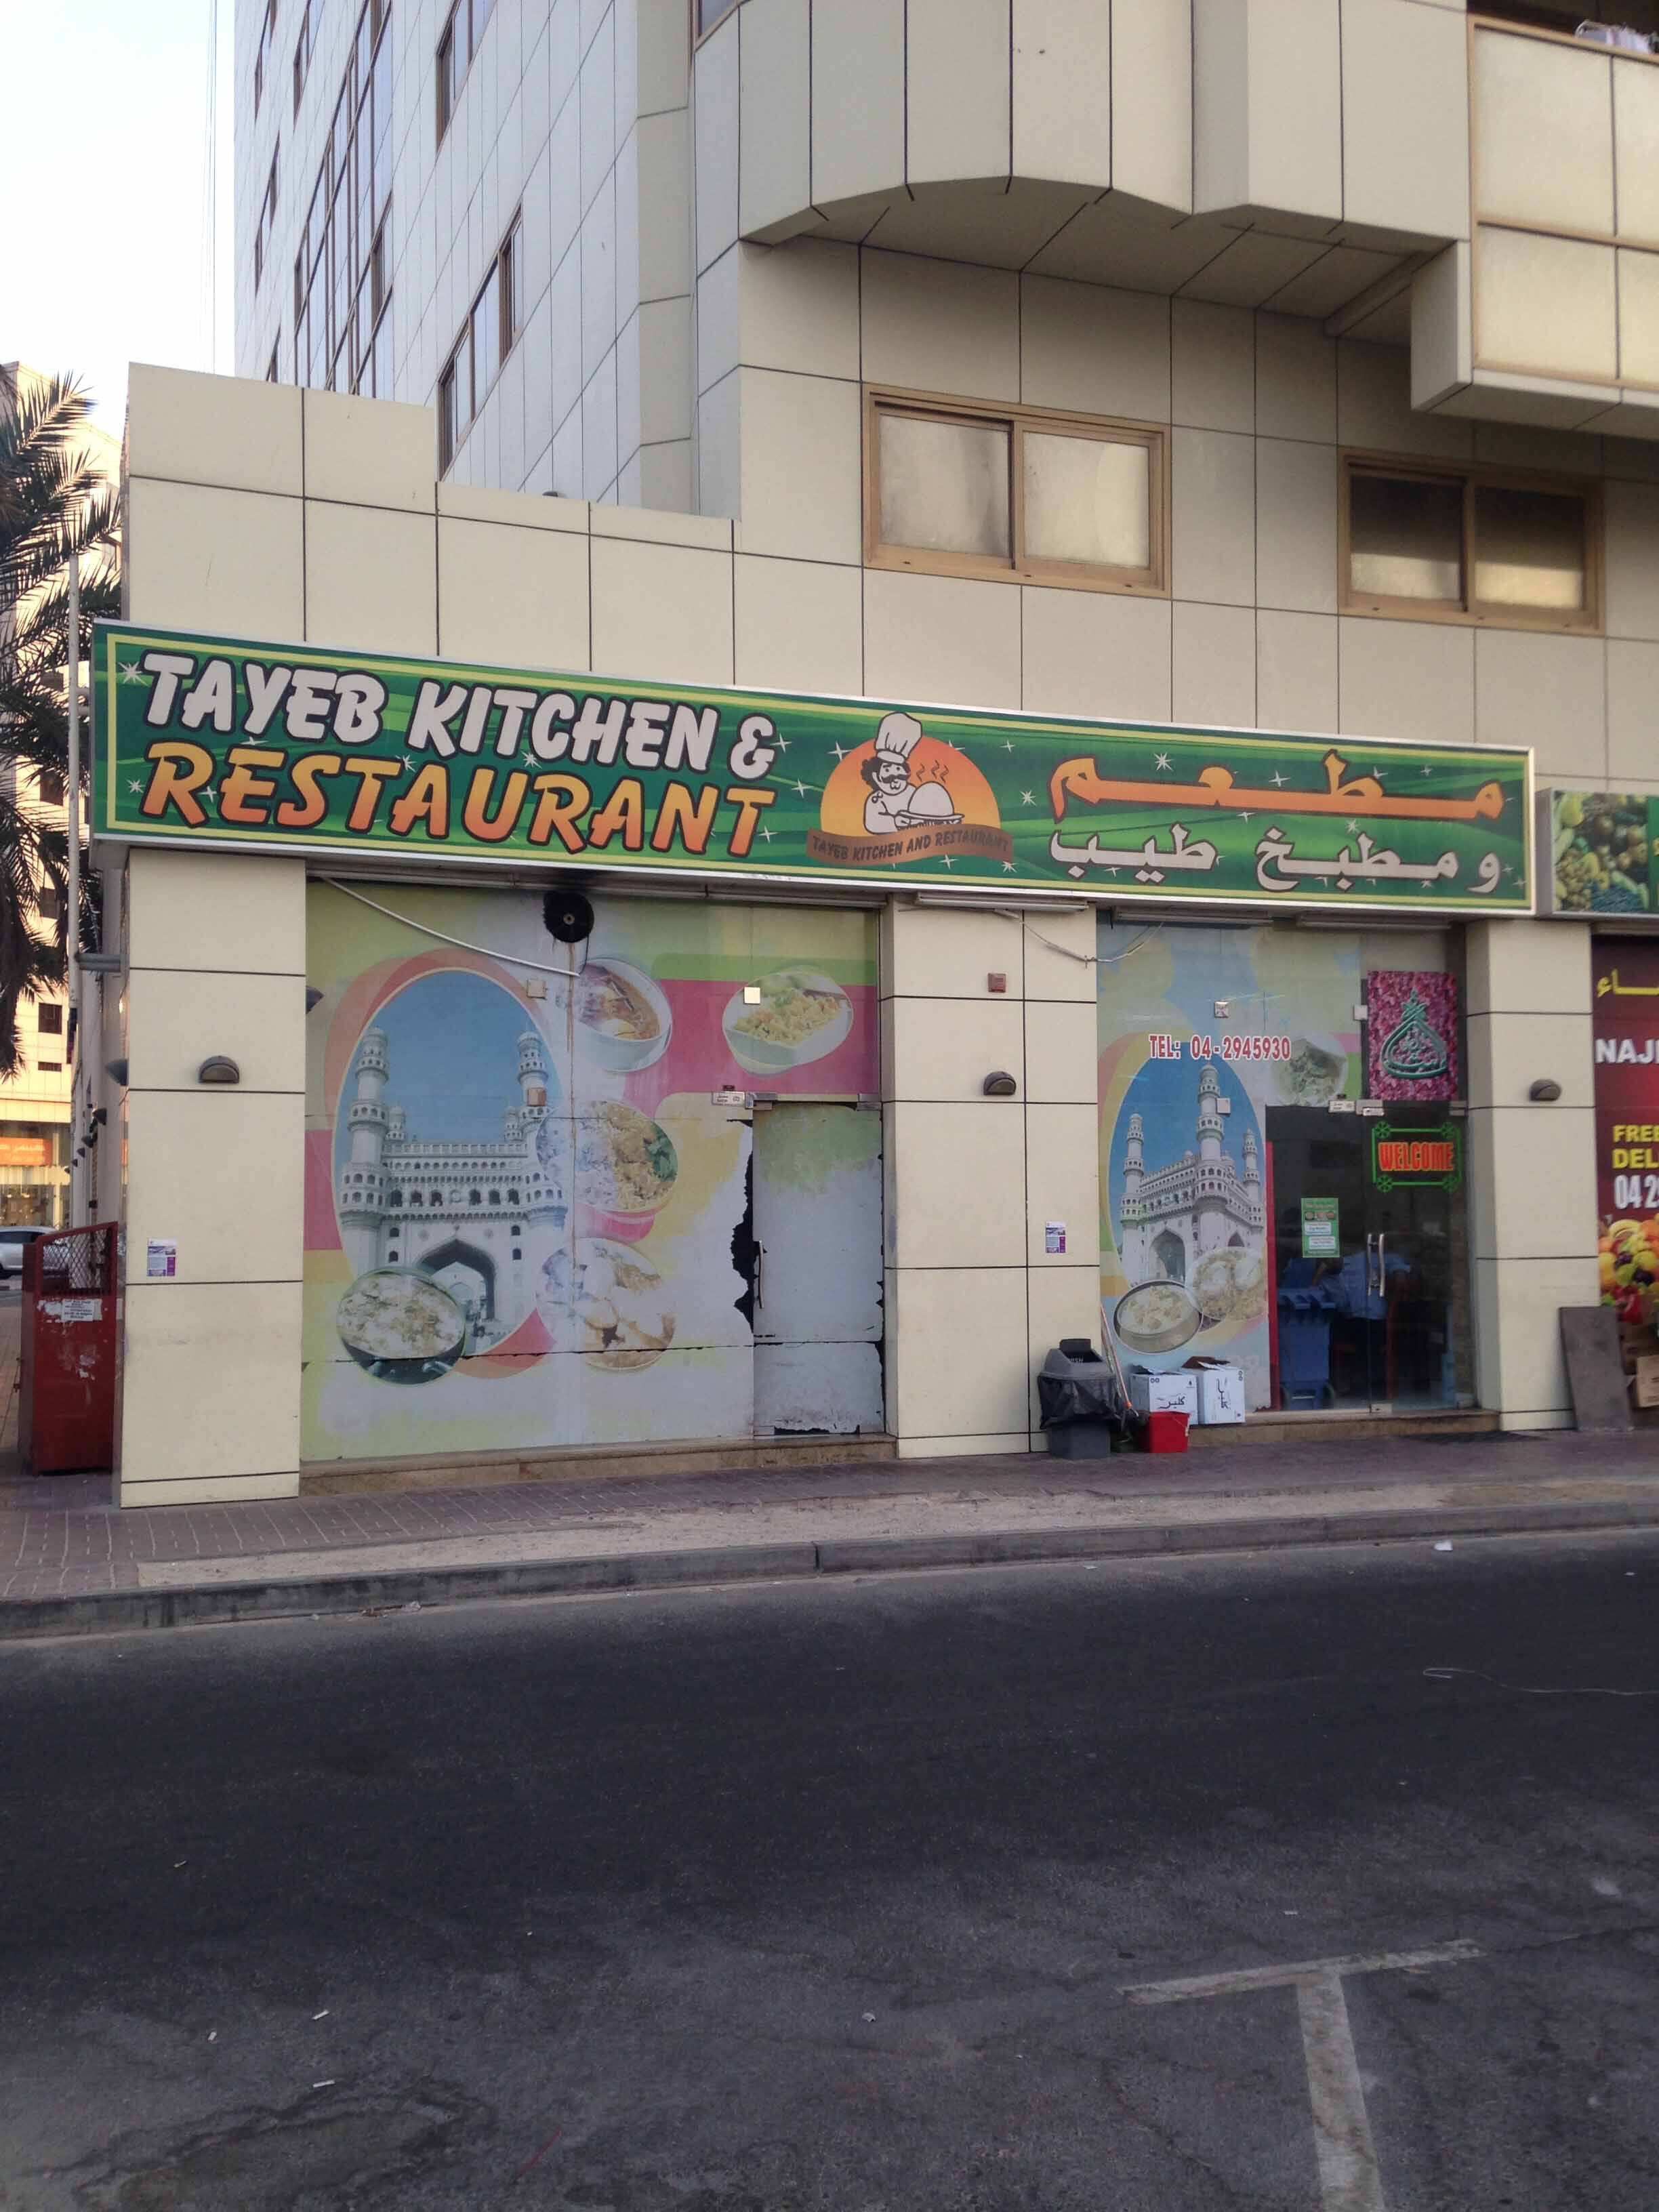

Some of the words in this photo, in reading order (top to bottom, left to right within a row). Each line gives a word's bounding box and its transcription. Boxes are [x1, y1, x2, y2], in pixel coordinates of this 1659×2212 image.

[141, 651, 387, 745] TAYEB
[407, 679, 719, 772] KITCHEN
[730, 715, 775, 779] &
[142, 742, 777, 855] RESTAURANT
[1049, 749, 1504, 823] مطعم
[813, 836, 848, 860] TAYEB
[853, 840, 903, 861] KITCHEN
[907, 834, 931, 854] AND
[935, 829, 1008, 853] RESTAURANT
[1050, 822, 1217, 884] طيب
[1149, 1034, 1181, 1059] TEL:
[1595, 1038, 1659, 1064] NAJ
[1378, 1141, 1454, 1172] WELCOME
